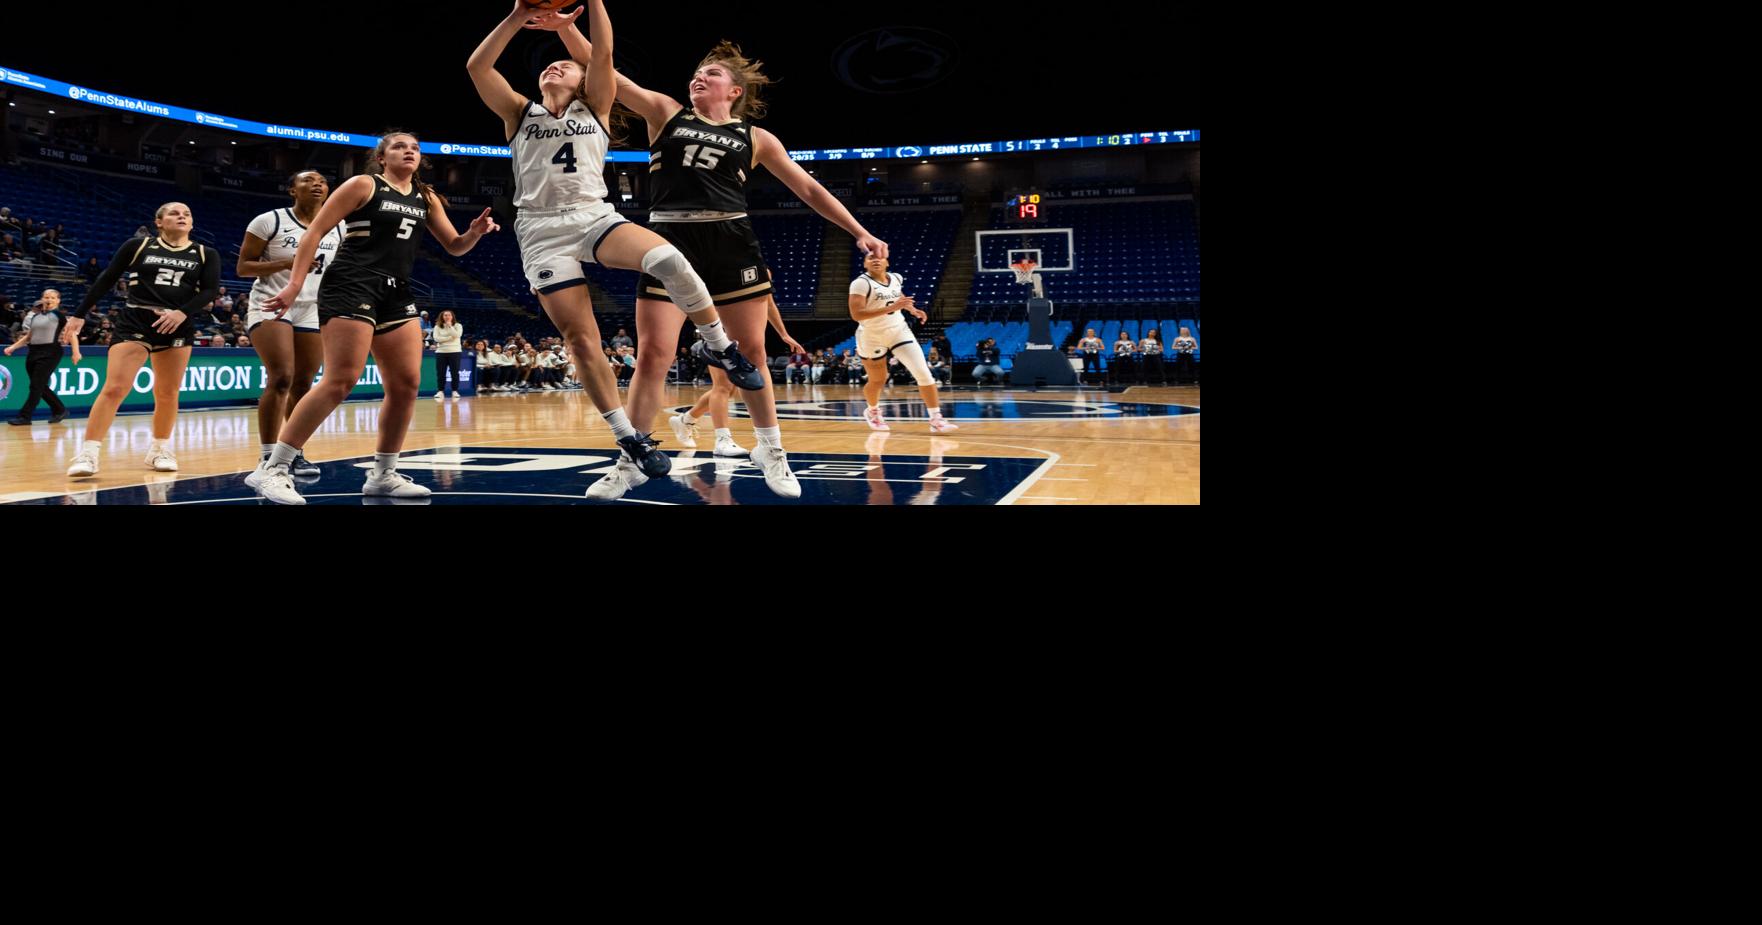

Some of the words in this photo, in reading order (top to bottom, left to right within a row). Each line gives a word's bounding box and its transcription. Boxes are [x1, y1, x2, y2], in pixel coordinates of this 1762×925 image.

[69, 87, 169, 115] @PennStateAlums
[266, 125, 349, 142] alumni.psu.edu
[525, 124, 561, 140] Penn
[672, 127, 742, 150] BRYANT
[440, 144, 512, 156] @PennState
[551, 142, 577, 173] 4
[682, 144, 727, 170] 15
[930, 145, 960, 155] PENN
[960, 143, 992, 154] STATE
[381, 201, 426, 218] BRYANT
[1020, 203, 1038, 218] 19
[396, 217, 417, 240] 5
[144, 256, 195, 269] BRYANT
[154, 268, 185, 287] 21
[743, 267, 758, 284] B
